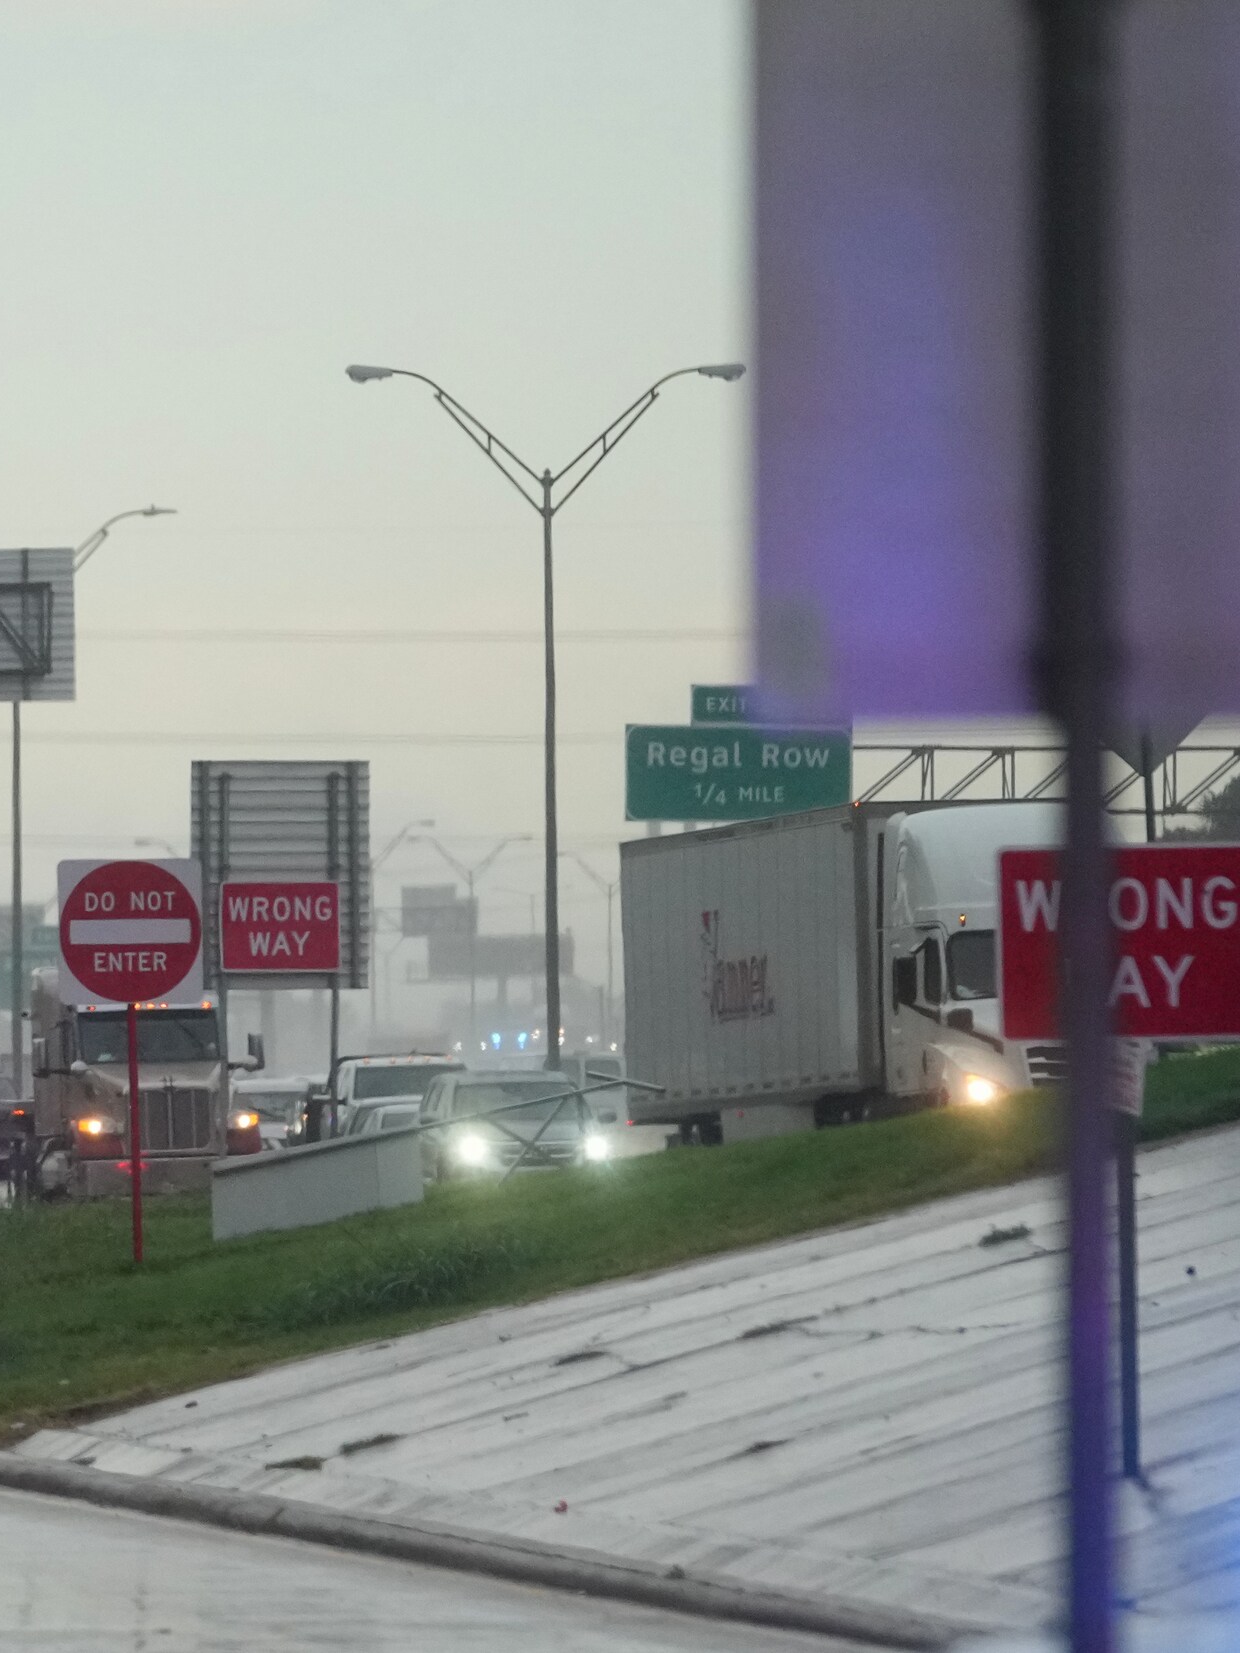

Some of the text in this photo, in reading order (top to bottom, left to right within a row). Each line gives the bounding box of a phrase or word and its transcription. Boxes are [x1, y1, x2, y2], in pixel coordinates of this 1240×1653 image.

[646, 741, 830, 774] Regal Row
[694, 783, 785, 806] 1/4 MILE
[84, 890, 176, 912] DO NOT
[228, 896, 333, 922] WRONG
[1015, 876, 1238, 932] WONG
[248, 931, 311, 957] WAY
[93, 951, 168, 973] ENTER
[1109, 955, 1195, 1008] AY
